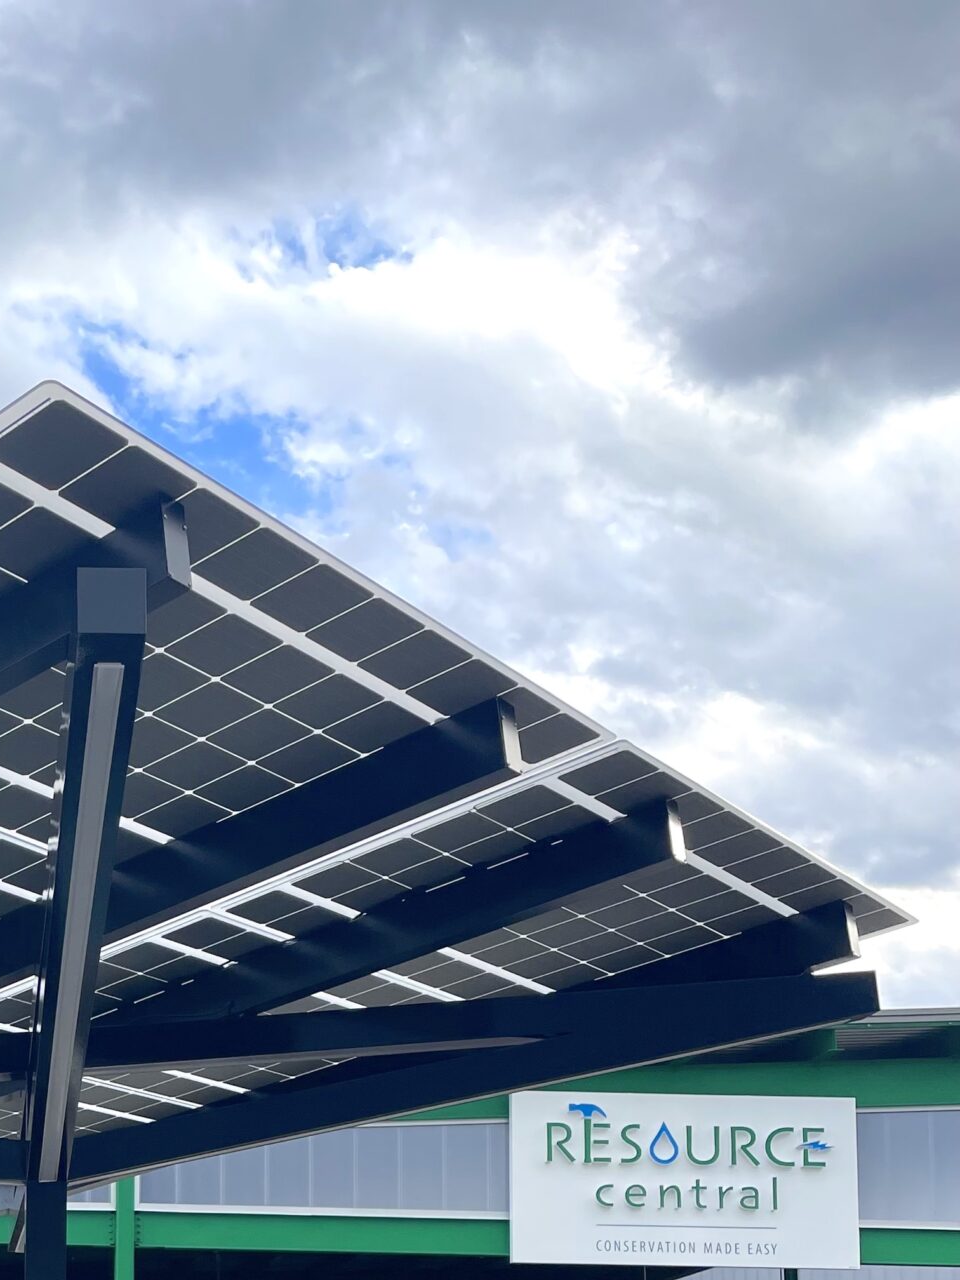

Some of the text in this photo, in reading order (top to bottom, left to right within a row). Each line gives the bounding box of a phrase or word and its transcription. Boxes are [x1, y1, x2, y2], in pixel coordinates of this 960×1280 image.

[545, 1104, 832, 1169] RESOURCE
[595, 1176, 779, 1211] central
[596, 1239, 778, 1256] CONSERVATION MADE EASY
